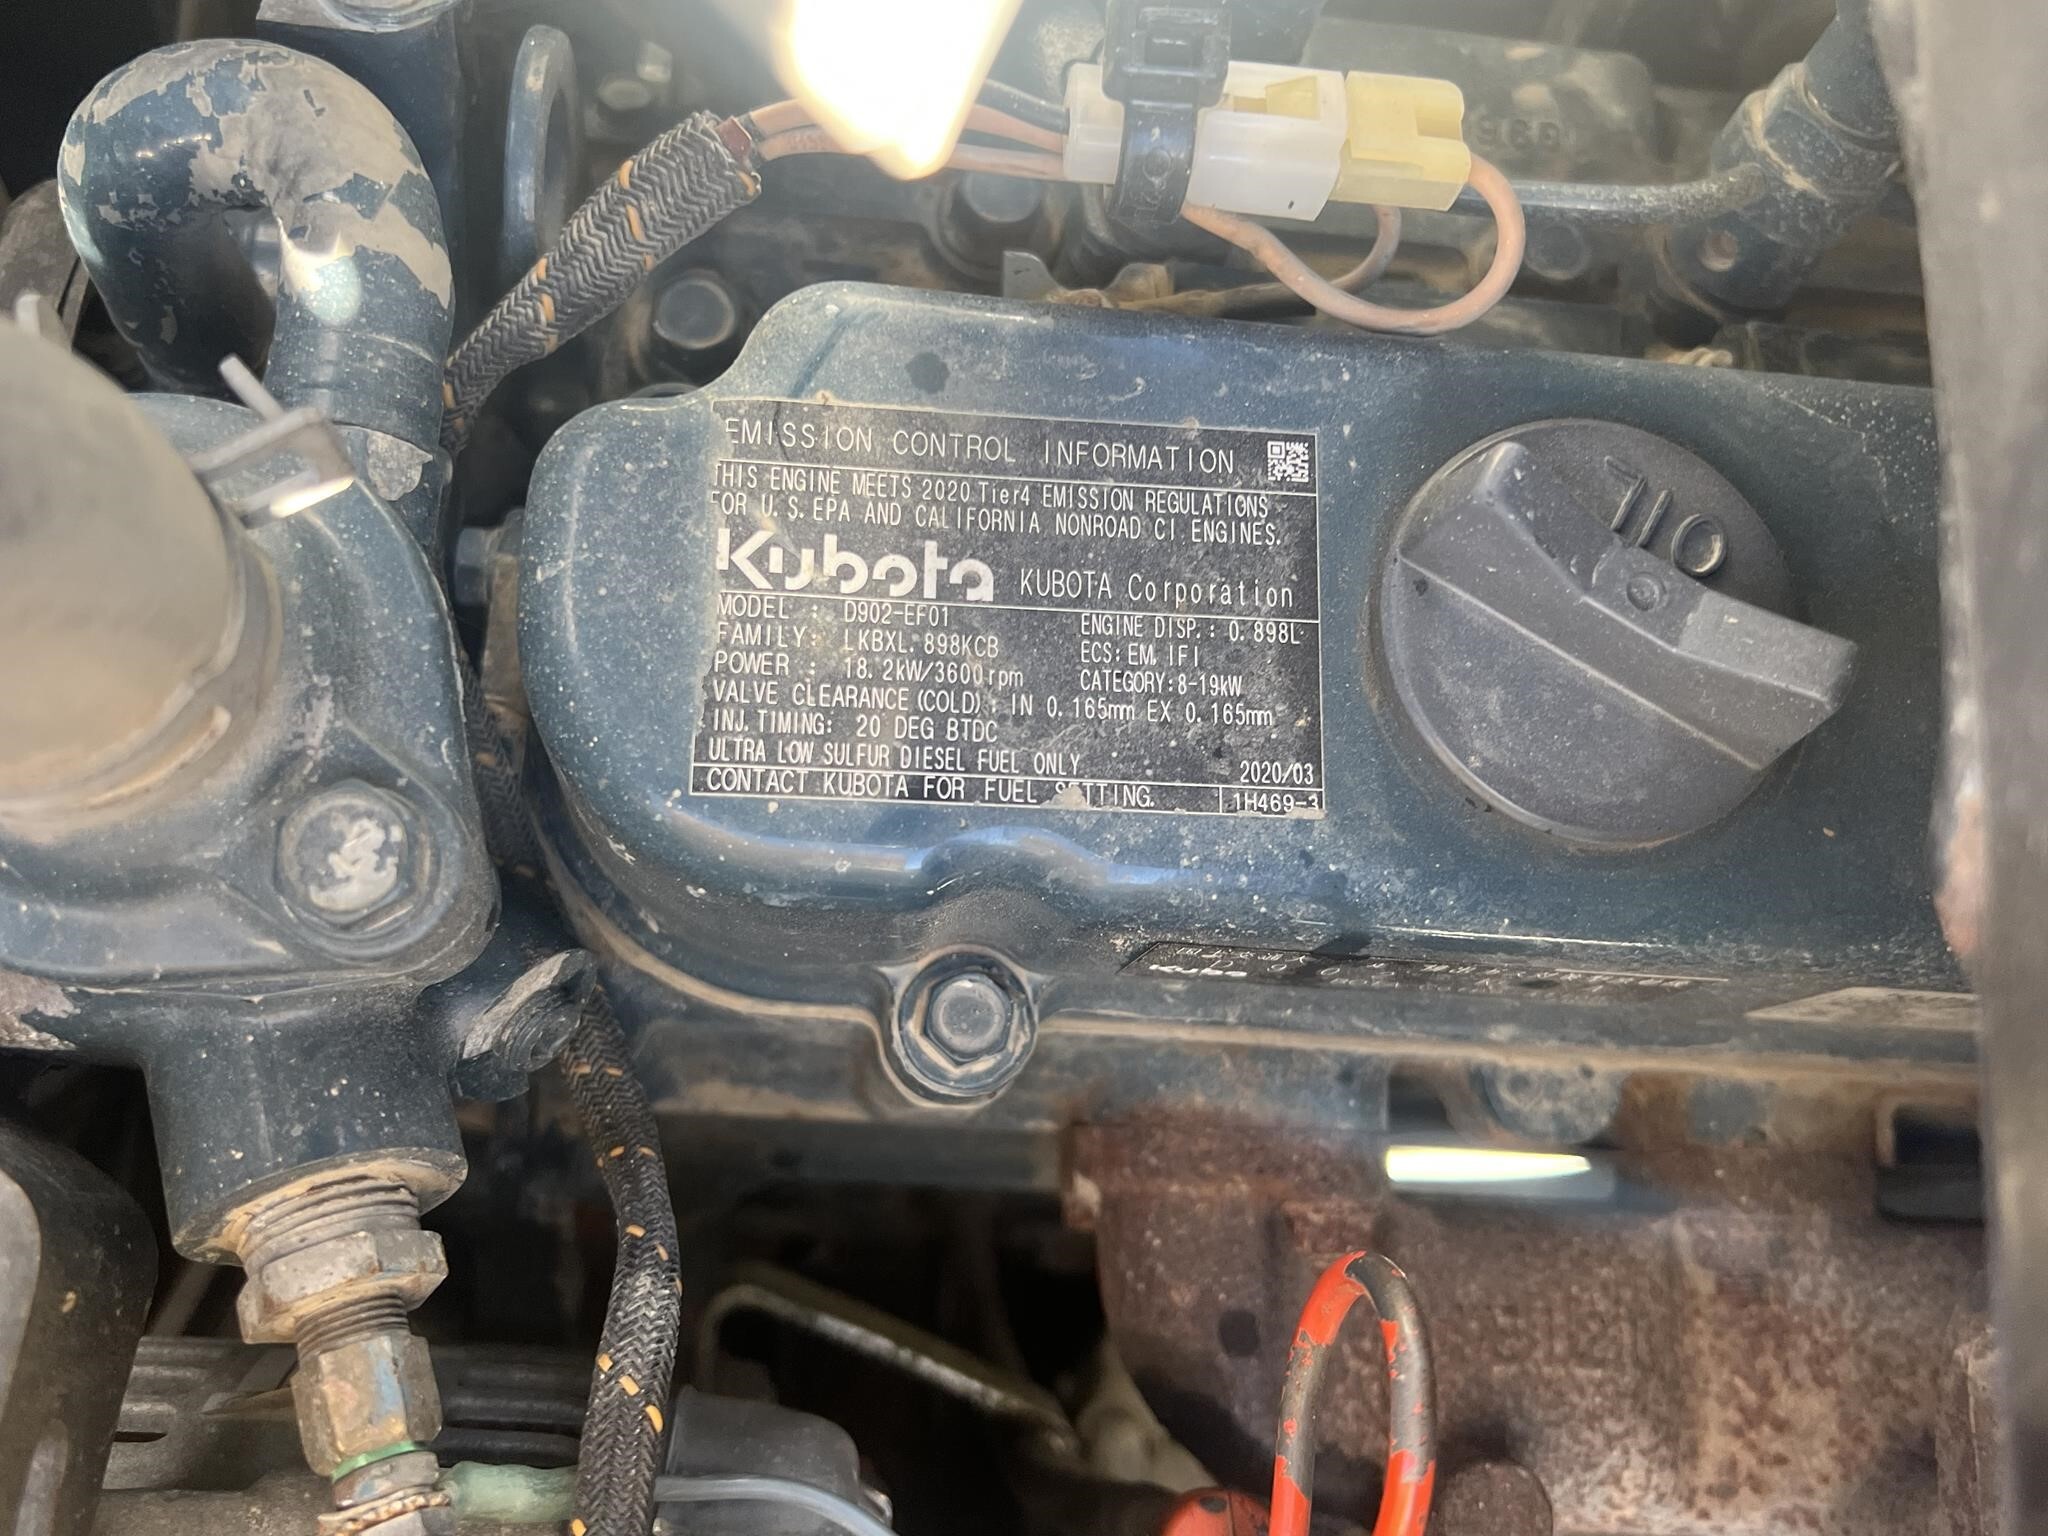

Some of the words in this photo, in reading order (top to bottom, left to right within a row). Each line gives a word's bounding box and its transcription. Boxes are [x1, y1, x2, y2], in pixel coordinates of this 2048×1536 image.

[725, 417, 873, 451] EMISSION
[893, 430, 1016, 463] CONTROL
[1044, 439, 1235, 475] INFORMATION
[713, 464, 758, 489] THIS
[770, 466, 841, 495] ENGINE
[852, 472, 912, 499] MEETS
[921, 479, 970, 502] 2020
[980, 482, 1031, 506] Tier4
[1042, 484, 1134, 511] EMISSION
[1145, 491, 1269, 518] REGULATIONS
[711, 491, 748, 516] FOR
[864, 501, 902, 526] AND
[915, 504, 1040, 534] CALIFORNIA
[1055, 512, 1142, 540] NONROAD
[1154, 518, 1176, 541] CI
[1191, 519, 1281, 546] ENGINES.
[715, 527, 994, 602] Kubota
[1020, 568, 1112, 600] KUBOTA
[1128, 573, 1294, 609] Corporation
[717, 593, 790, 619] MODEL
[844, 600, 949, 627] D902-EF01
[1081, 613, 1144, 637] ENGINE
[718, 621, 809, 648] FAMILY
[714, 650, 790, 676] POWER
[712, 679, 779, 705] VALVE
[792, 683, 909, 712] CLEARANCE
[1011, 693, 1033, 717] IN
[1147, 699, 1171, 723] EX
[856, 714, 881, 738] 20
[894, 716, 935, 740] DEG
[946, 718, 999, 743] BTDC
[708, 736, 766, 763] ULTRA
[777, 739, 815, 765] LOW
[824, 743, 890, 769] SULFUR
[900, 746, 965, 772] DIESEL
[977, 749, 1020, 774] FUEL
[1034, 752, 1081, 777] ONLY
[1239, 760, 1315, 786] 2020/03
[706, 767, 809, 794] CONTACT
[823, 772, 909, 798] KUBOTA
[923, 775, 965, 800] FOR
[985, 779, 1037, 804] FUEL
[1055, 781, 1155, 808] TTING.
